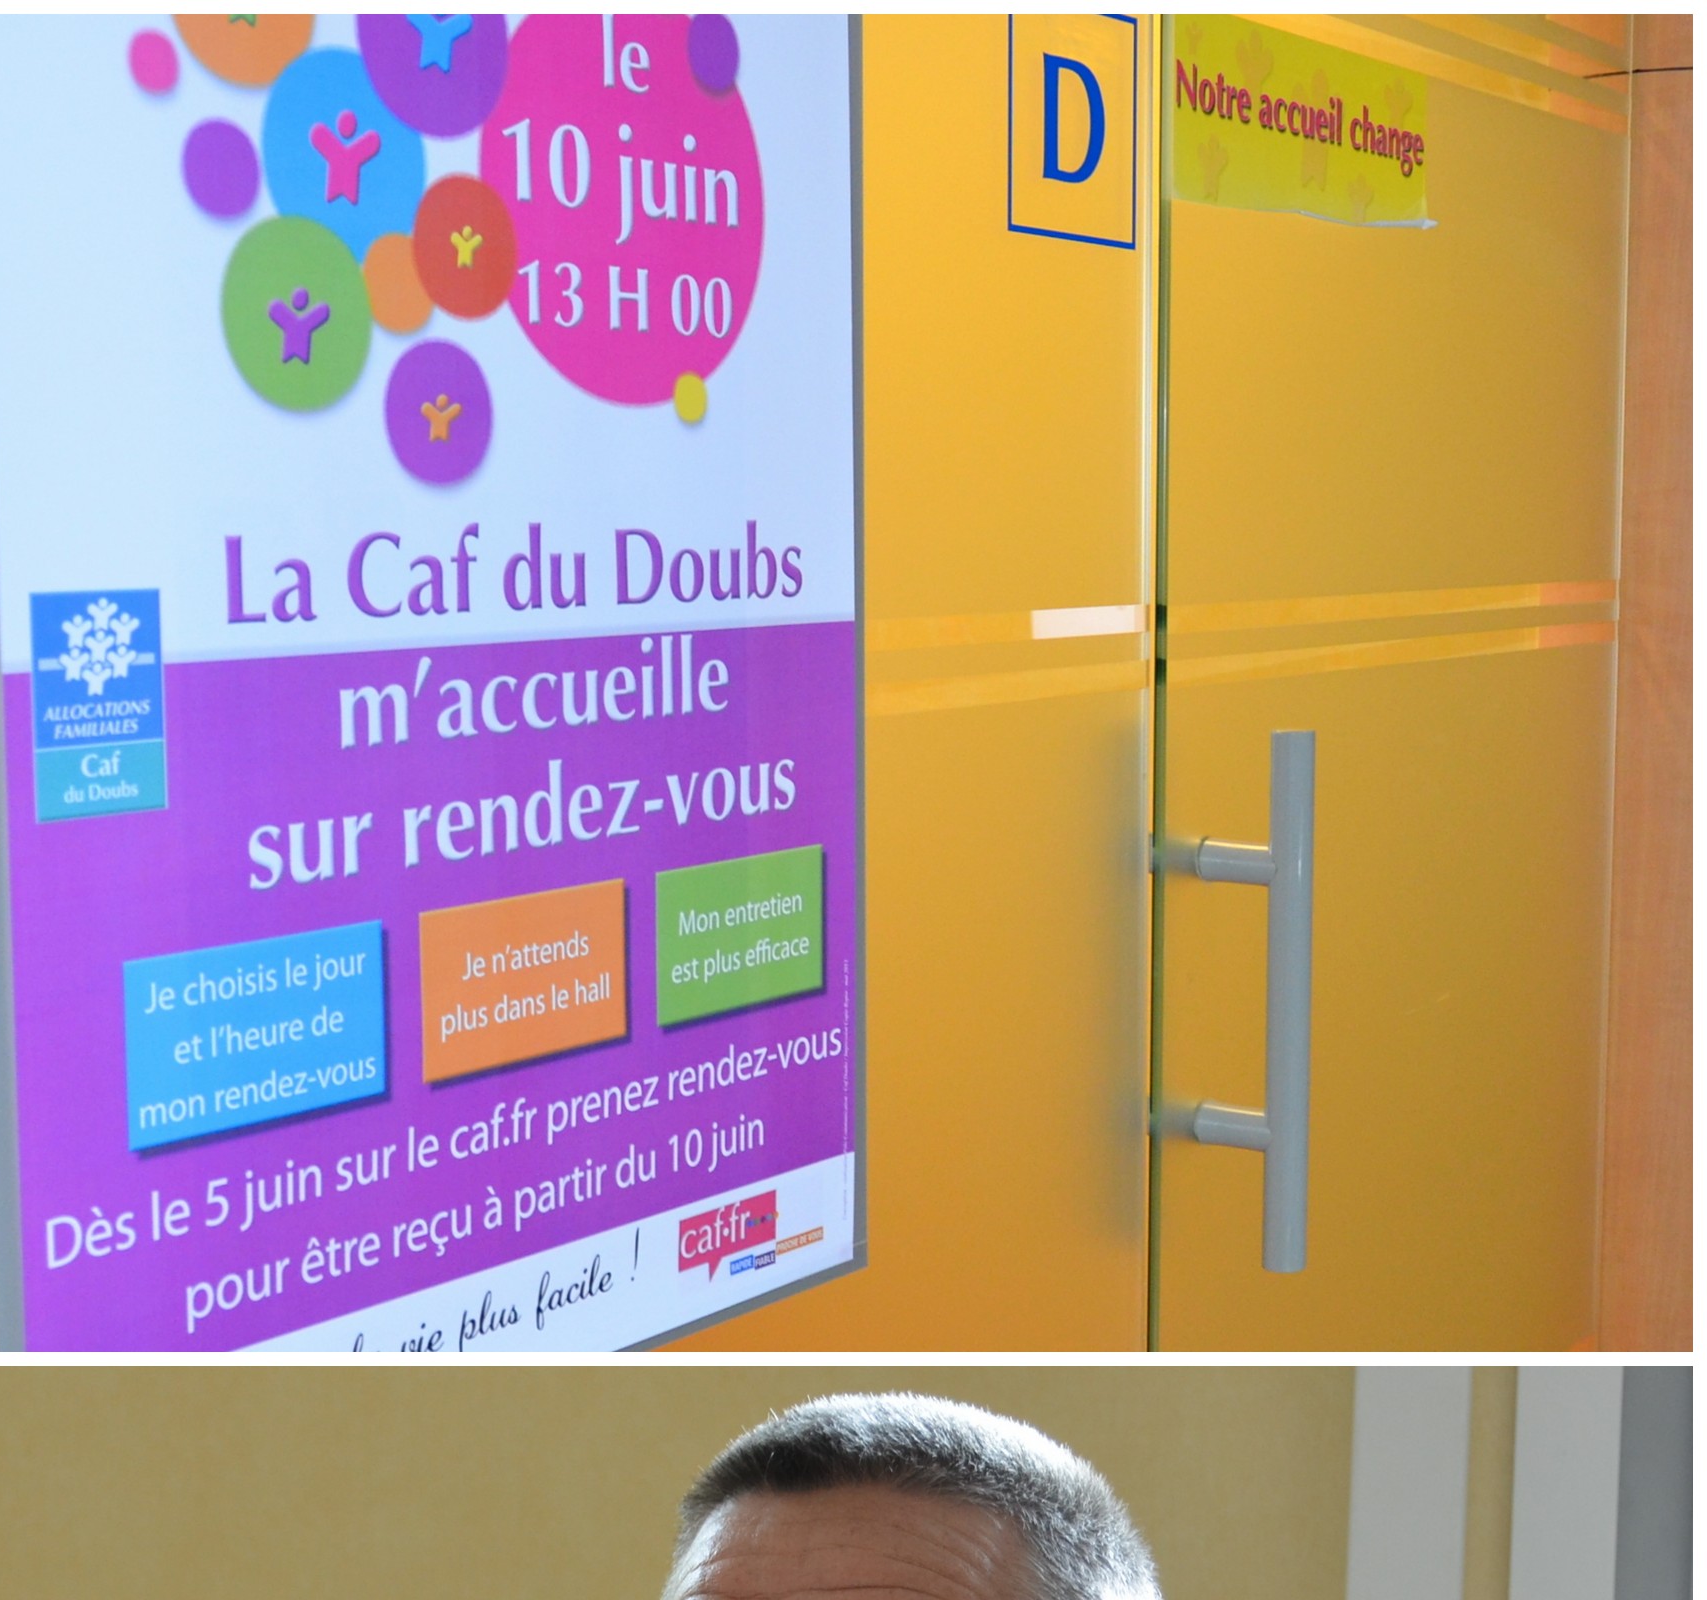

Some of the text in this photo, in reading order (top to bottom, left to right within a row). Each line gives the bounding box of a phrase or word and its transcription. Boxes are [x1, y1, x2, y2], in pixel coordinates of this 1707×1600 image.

[602, 14, 650, 94] le
[1043, 52, 1106, 184] D
[1175, 58, 1425, 177] Notre accueil change
[502, 118, 739, 246] 10 juin
[517, 259, 733, 339] 13 H 00
[224, 519, 804, 625] La Caf du Doubs
[43, 699, 151, 722] ALLOCATIONS
[53, 718, 139, 740] FAMILIALES
[63, 780, 139, 804] du Doubs
[80, 750, 121, 778] Caf
[248, 755, 797, 890] sur rendez-vous
[678, 892, 803, 937] Mon entretien
[144, 953, 366, 1014] Je choisis le jour
[462, 952, 487, 981] Je
[671, 934, 810, 985] est plus efficace
[173, 1034, 204, 1065] et
[311, 1005, 345, 1037] de
[440, 972, 611, 1043] plus dans le hall
[139, 1056, 377, 1130] mon rendez-vous
[45, 1027, 843, 1270] Dès le 5 juin sur le caf.fr prenez rendez-vous
[185, 1113, 765, 1334] pour être reçu à partir du 10 juin
[755, 1252, 775, 1268] FIABLE
[458, 1291, 522, 1352] plus
[535, 1270, 614, 1329] facile
